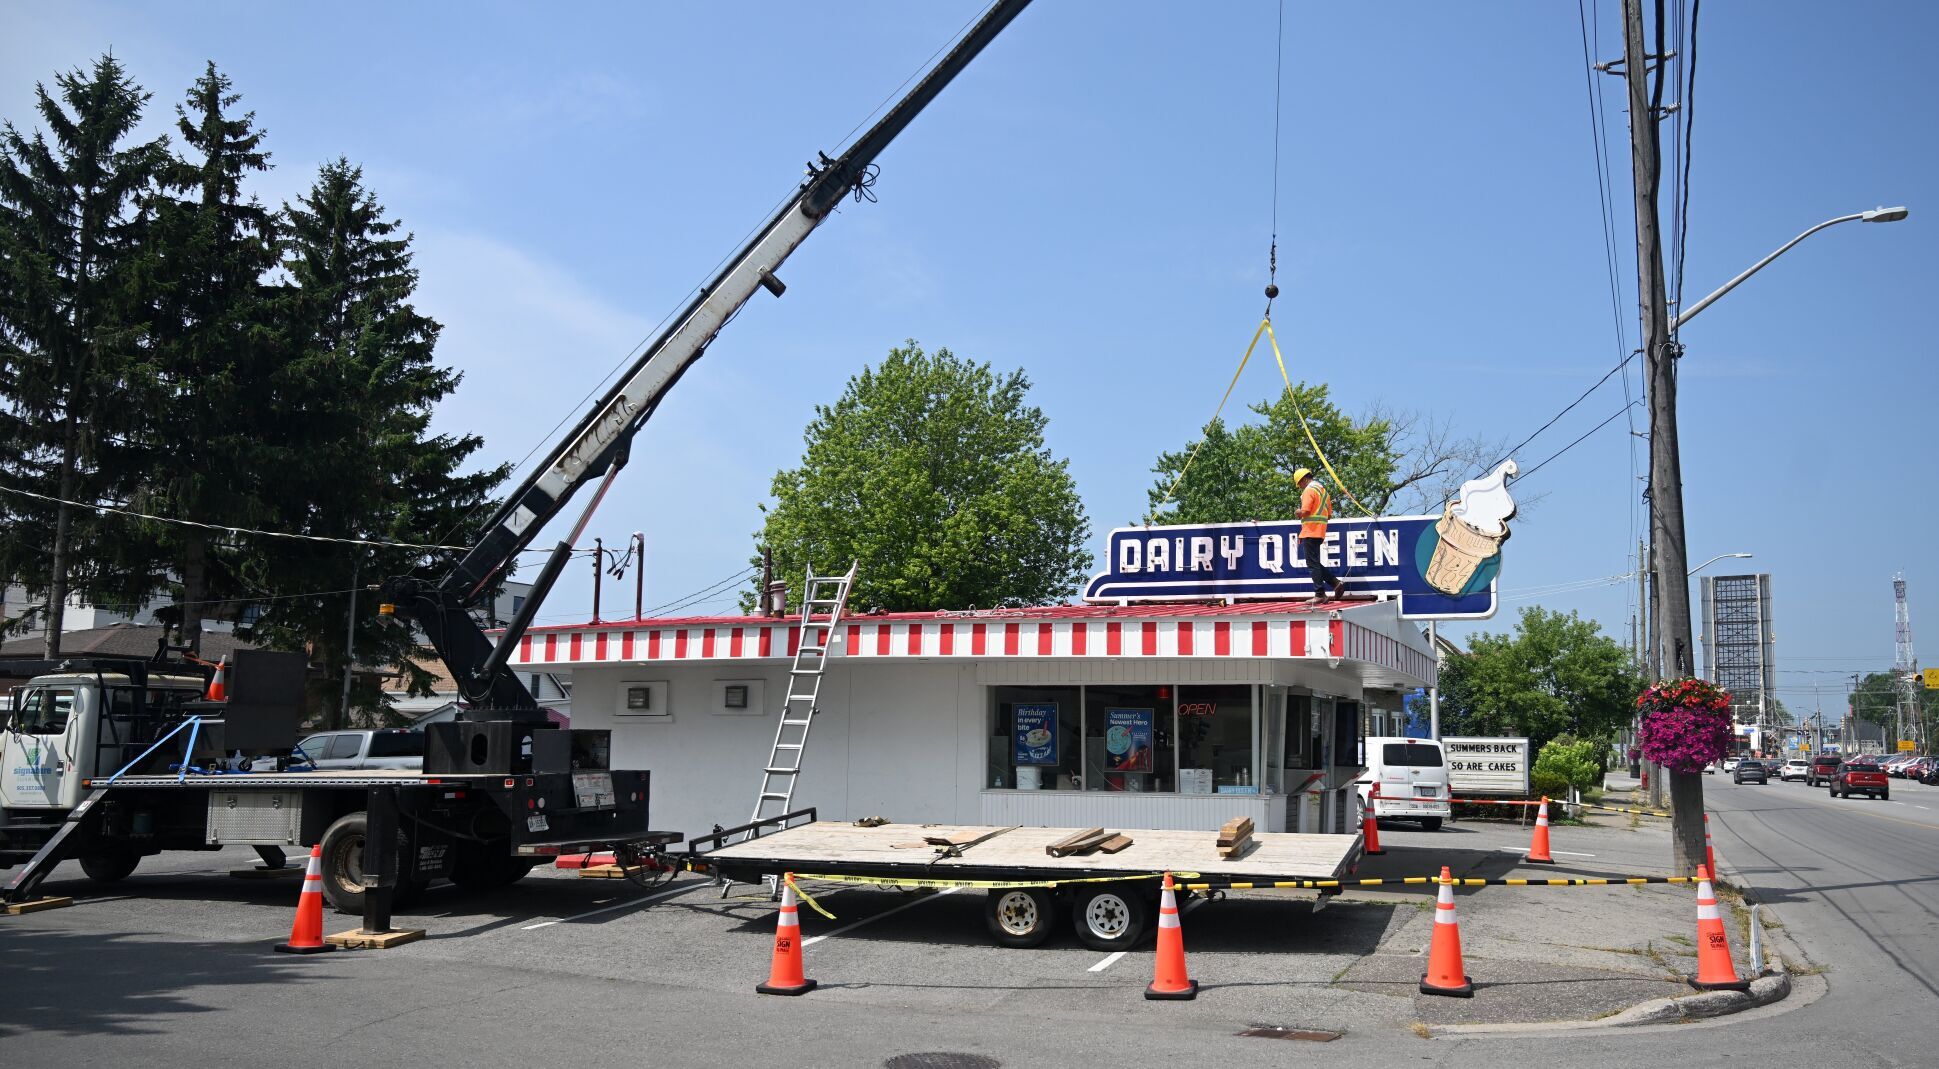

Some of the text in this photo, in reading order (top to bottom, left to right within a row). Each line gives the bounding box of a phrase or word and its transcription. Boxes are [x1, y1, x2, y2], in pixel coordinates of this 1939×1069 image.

[1119, 529, 1399, 574] DAIRY QUEEN
[1018, 709, 1047, 718] Birthday
[1178, 703, 1217, 715] OPEN
[1110, 711, 1141, 720] Summer's
[1024, 717, 1042, 725] every
[1450, 744, 1517, 753] SUMMERS BACK
[1451, 761, 1516, 771] SO ARE CAKES
[776, 940, 791, 948] SIGN
